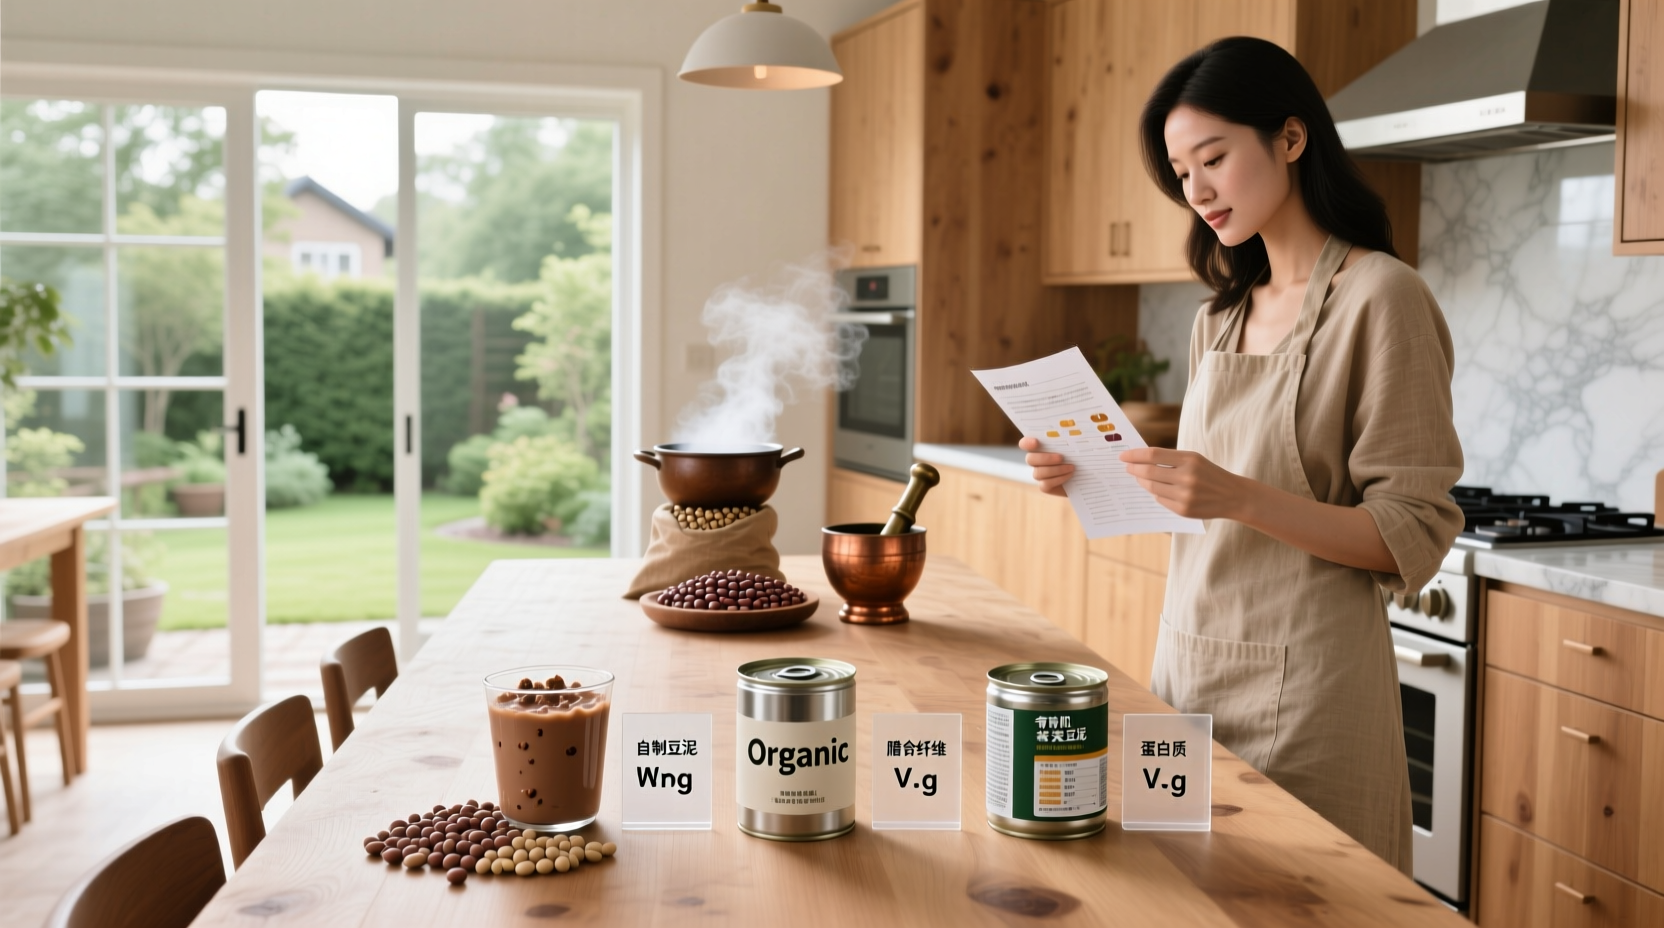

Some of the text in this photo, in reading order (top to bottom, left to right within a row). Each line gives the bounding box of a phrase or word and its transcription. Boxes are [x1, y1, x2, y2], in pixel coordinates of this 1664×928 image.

[638, 739, 698, 757] 自制豆泥
[748, 737, 849, 775] Organic
[1140, 739, 1187, 757] 蛋白质
[636, 766, 693, 795] Wng
[893, 767, 938, 797] V.g
[1142, 767, 1187, 798] V.g
